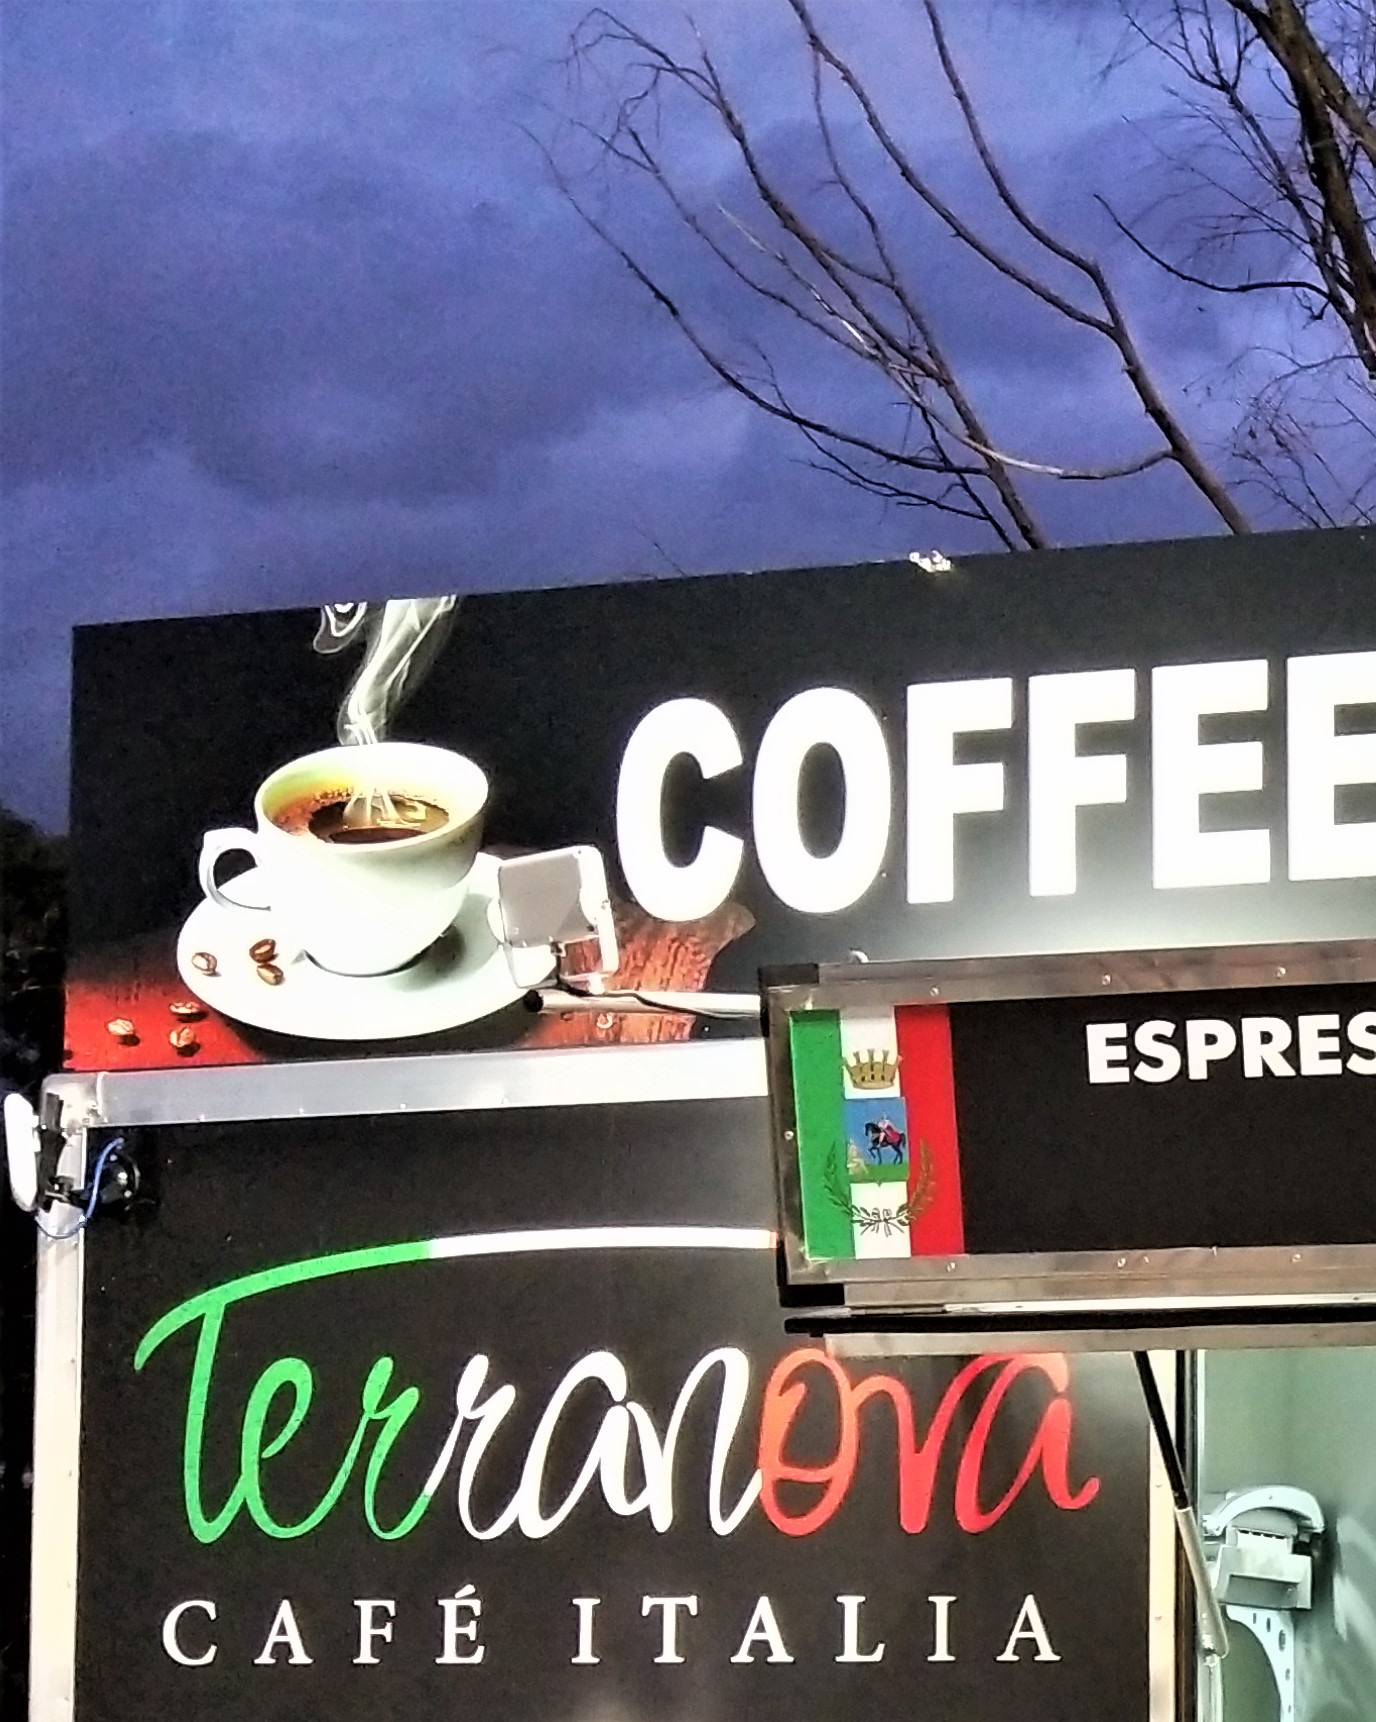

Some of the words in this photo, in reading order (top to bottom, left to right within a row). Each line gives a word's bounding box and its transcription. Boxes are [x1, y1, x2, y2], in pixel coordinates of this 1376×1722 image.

[134, 1226, 1099, 1543] Terranova
[162, 1583, 486, 1666] CAFÉ
[571, 1594, 1061, 1664] ITALIA
